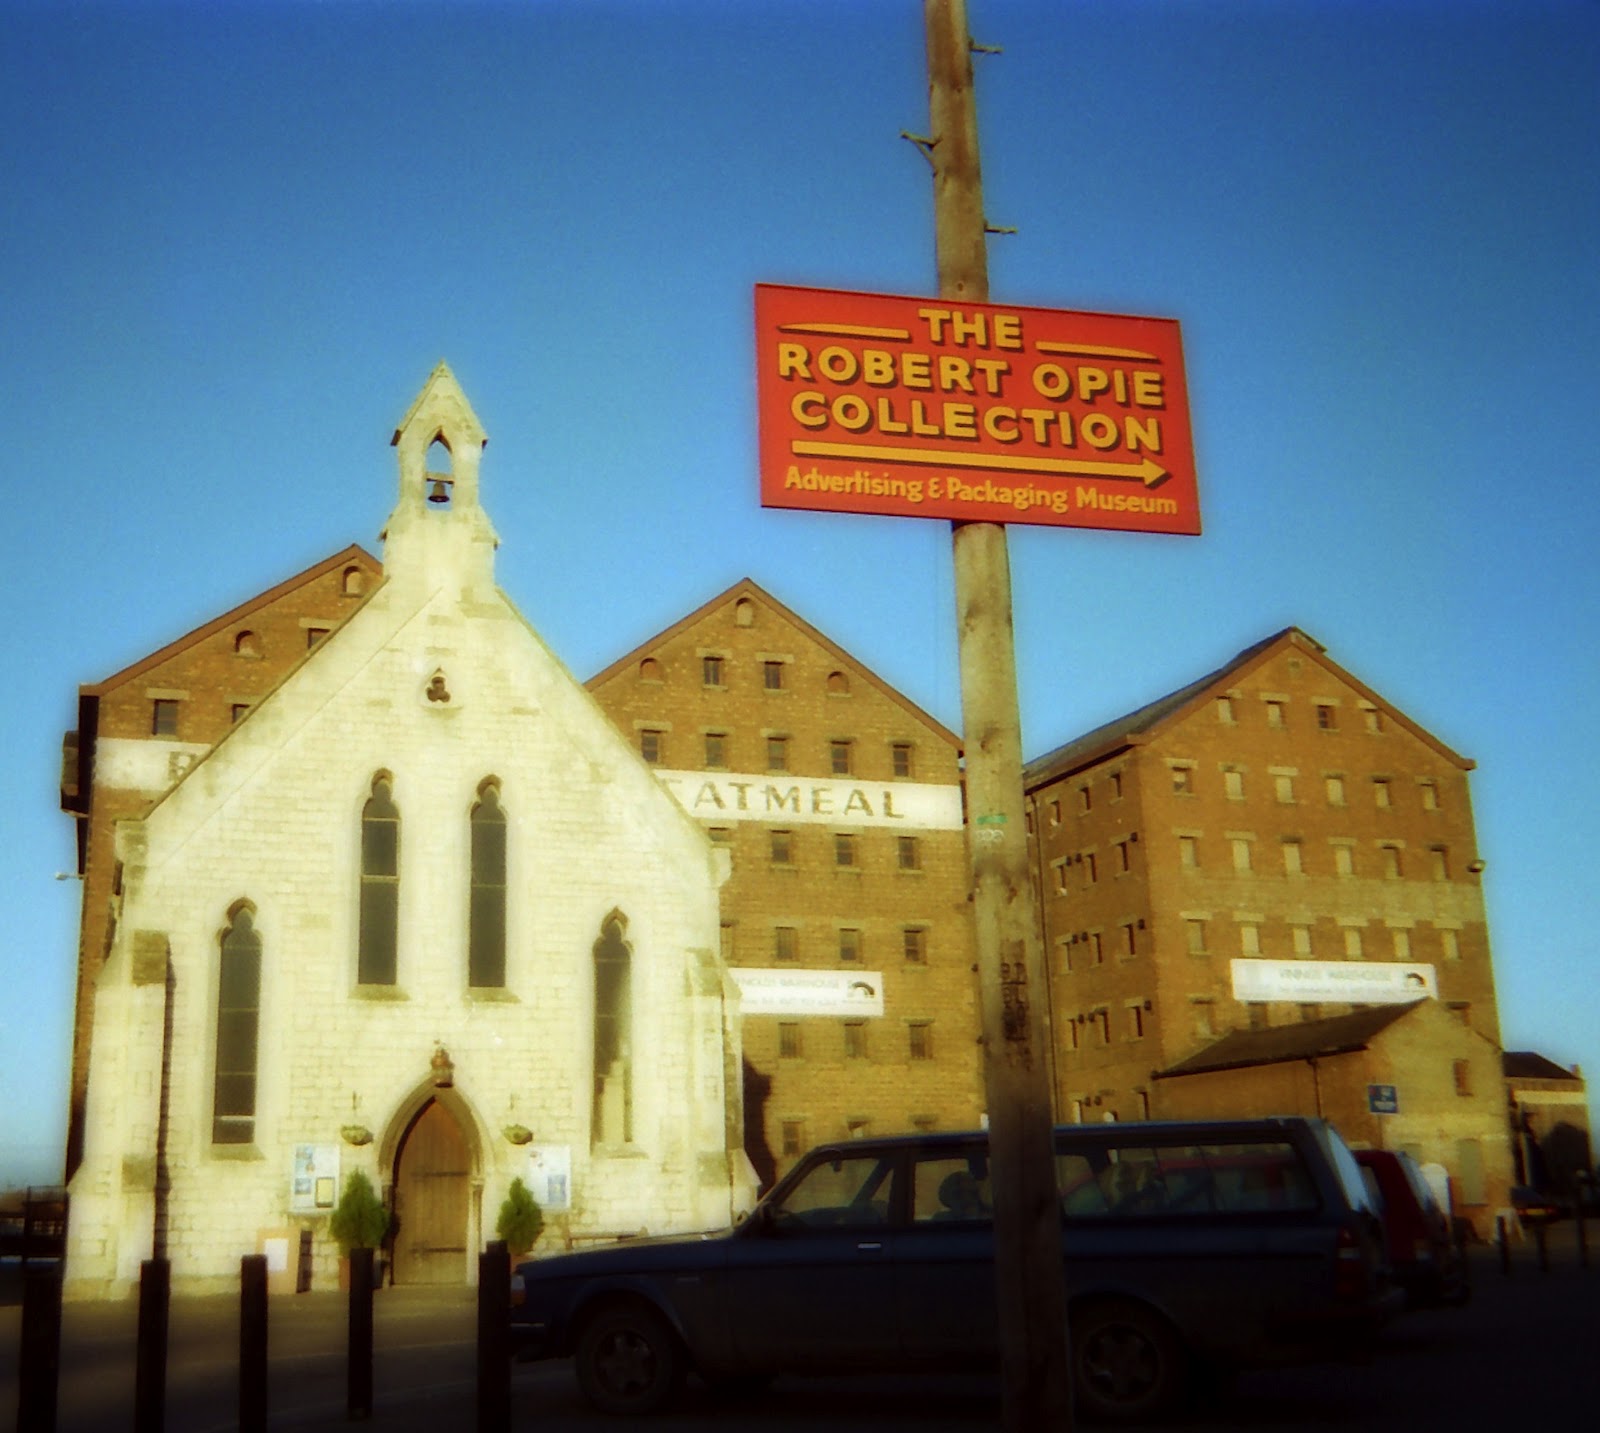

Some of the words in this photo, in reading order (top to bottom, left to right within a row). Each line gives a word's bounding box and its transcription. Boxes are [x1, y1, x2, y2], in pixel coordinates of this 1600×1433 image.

[918, 308, 1022, 349] THE
[777, 342, 1009, 393] ROBERT
[1032, 363, 1163, 406] OPIE
[791, 391, 1161, 452] COLLECTION
[785, 466, 924, 502] Advertising
[928, 477, 943, 499] &
[947, 477, 1068, 511] Packaging
[1076, 487, 1178, 515] Museum
[661, 779, 904, 819] ATMEAL
